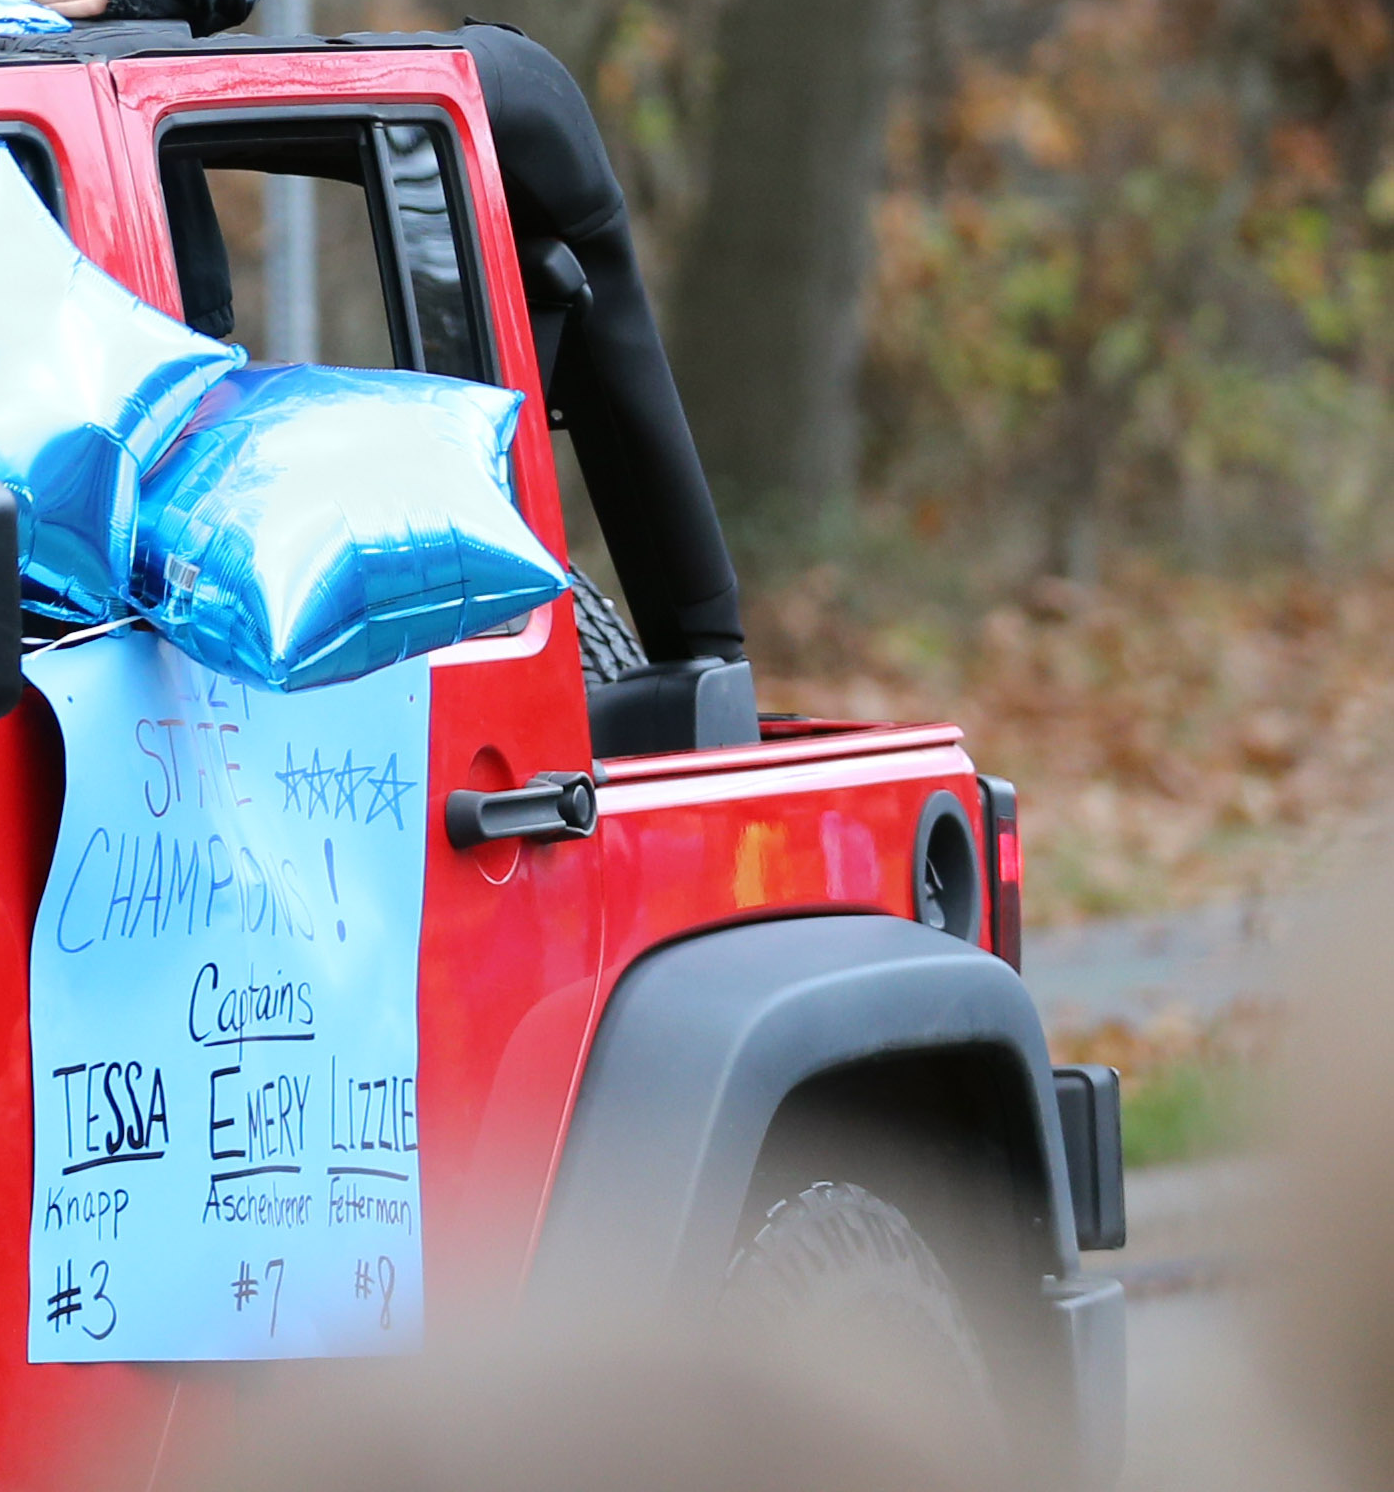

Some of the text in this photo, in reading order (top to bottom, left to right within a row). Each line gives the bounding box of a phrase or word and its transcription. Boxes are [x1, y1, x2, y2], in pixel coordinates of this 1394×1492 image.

[188, 963, 315, 1061] Captains
[53, 1061, 170, 1156] TESSA
[44, 1186, 130, 1240] Knapp
[327, 1175, 412, 1236] Fetterman
[46, 1255, 396, 1340] #3 #7 #8
